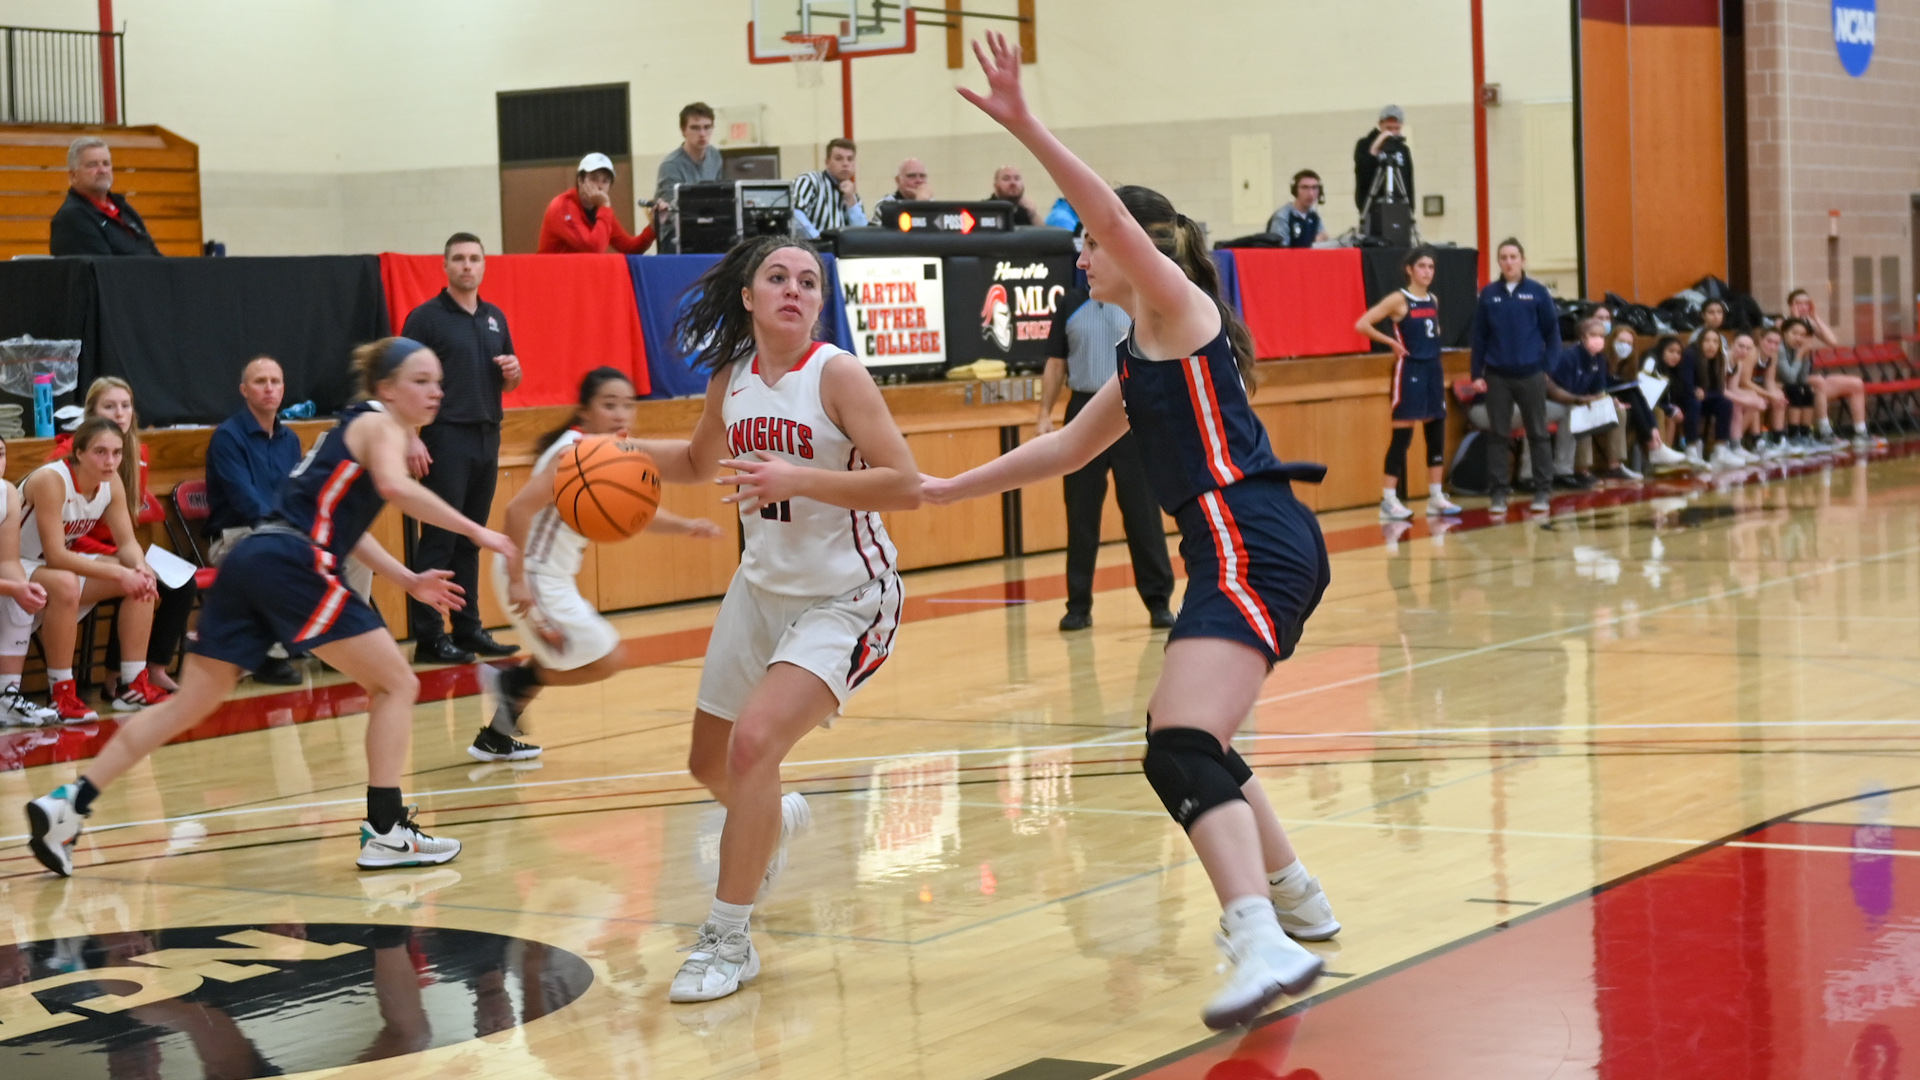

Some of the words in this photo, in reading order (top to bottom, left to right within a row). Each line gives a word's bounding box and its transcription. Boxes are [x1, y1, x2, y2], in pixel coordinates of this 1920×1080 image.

[1836, 7, 1875, 46] NCAA
[993, 261, 1024, 281] Home
[844, 282, 917, 304] MARTIN
[1014, 285, 1065, 316] MLC
[856, 307, 927, 332] LUTHER
[1424, 318, 1435, 338] 2
[865, 331, 940, 356] COLLEGE
[727, 416, 814, 460] NIGHTS
